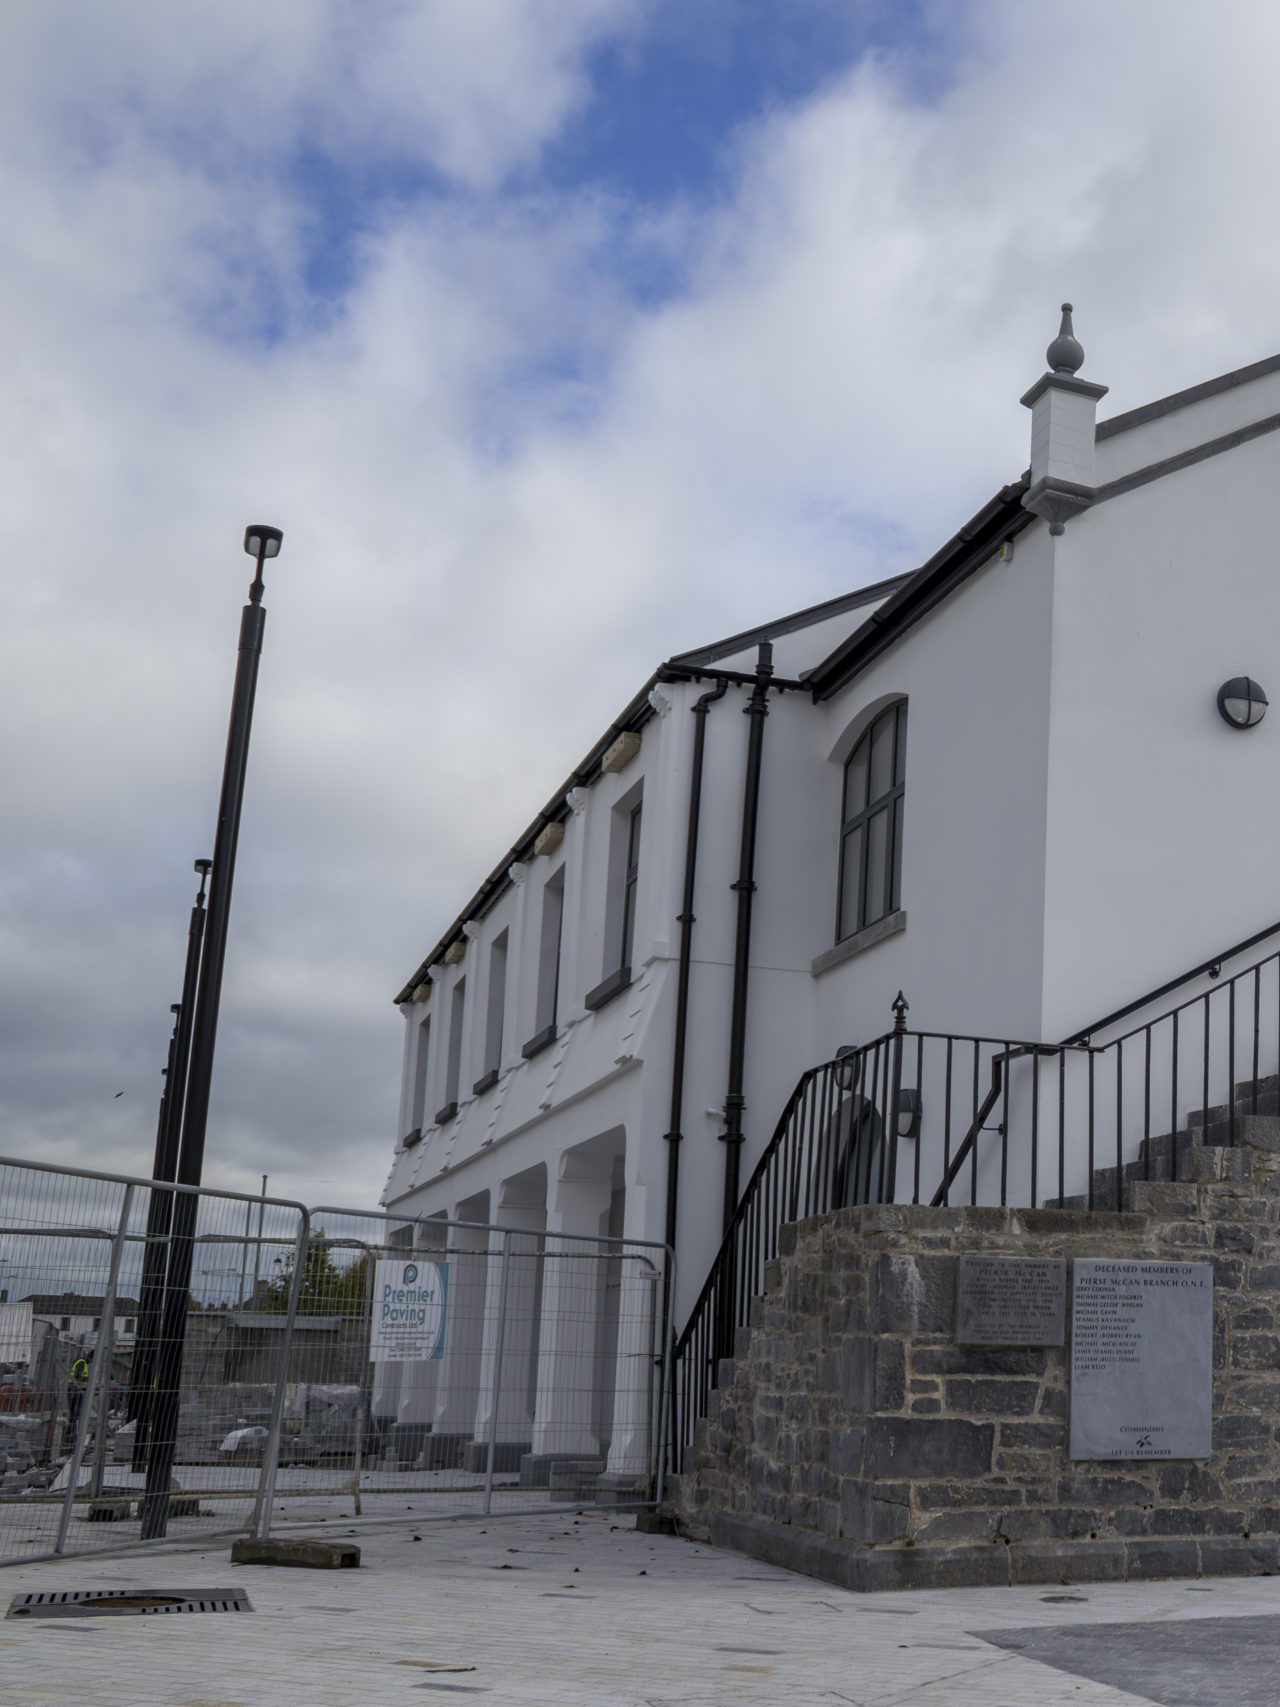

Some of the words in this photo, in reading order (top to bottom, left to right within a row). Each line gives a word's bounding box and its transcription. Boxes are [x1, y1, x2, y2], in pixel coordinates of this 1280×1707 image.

[1095, 1264, 1137, 1273] DECEASED
[1140, 1266, 1179, 1275] MEMBERS
[1181, 1267, 1192, 1275] OF
[1080, 1277, 1107, 1286] PIERSE
[1110, 1278, 1140, 1287] McCAN
[1143, 1279, 1178, 1288] BRANCH
[384, 1284, 435, 1303] Premier
[382, 1303, 426, 1326] Paving
[382, 1321, 407, 1329] Contracts
